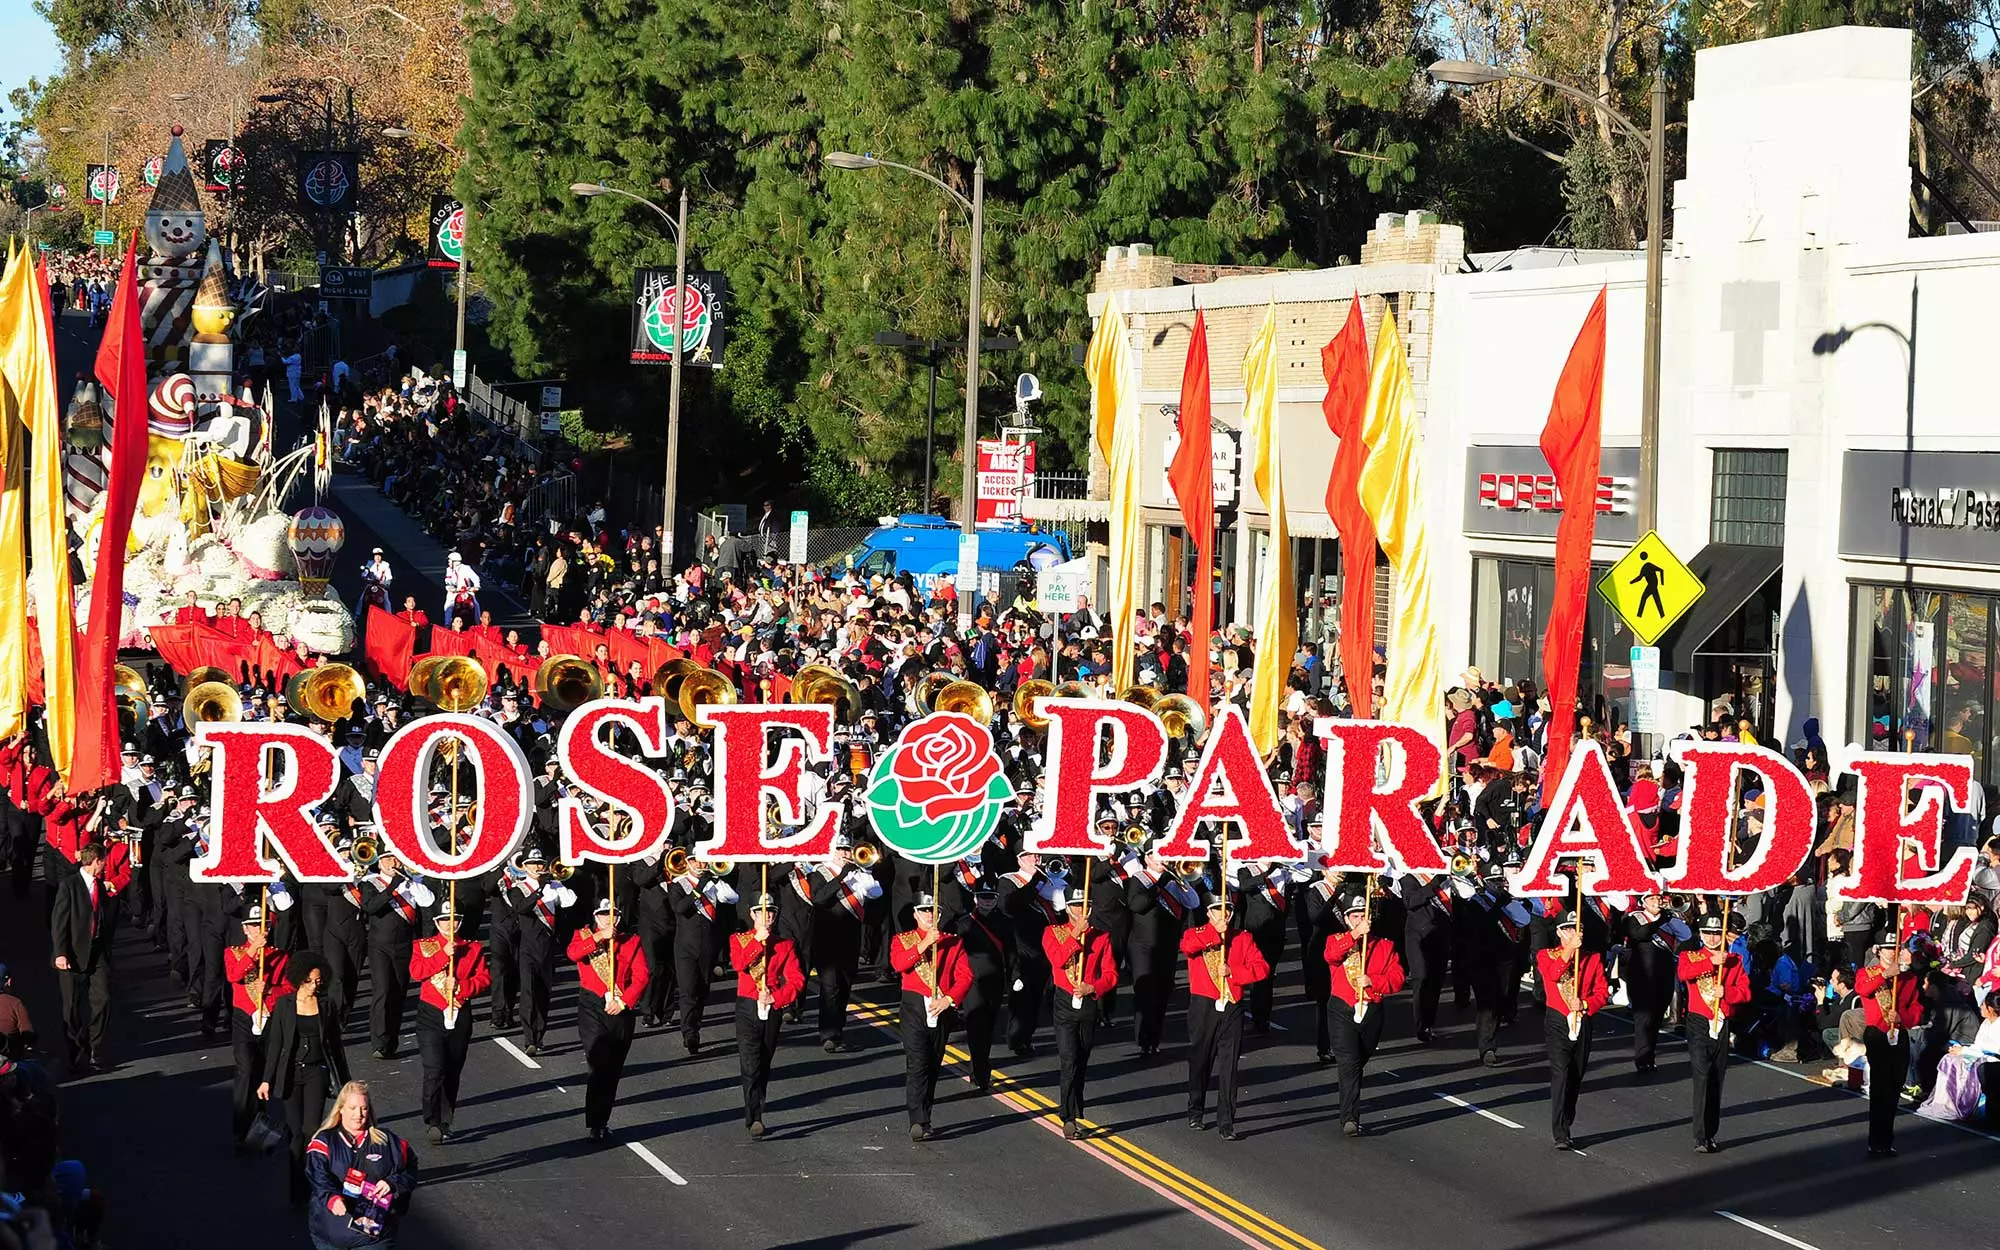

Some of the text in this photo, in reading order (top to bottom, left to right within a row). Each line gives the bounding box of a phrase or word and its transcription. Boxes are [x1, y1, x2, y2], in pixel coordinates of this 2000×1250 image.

[432, 200, 459, 226] ROSE
[636, 275, 671, 306] ROSE
[631, 352, 671, 360] HONDA
[984, 475, 1016, 485] ACCESS
[982, 486, 1009, 496] TICKET
[1891, 487, 1944, 524] Rusnak
[1048, 584, 1067, 592] PAY
[1044, 593, 1071, 601] HERE
[189, 696, 1979, 907] ROSE PARADE
